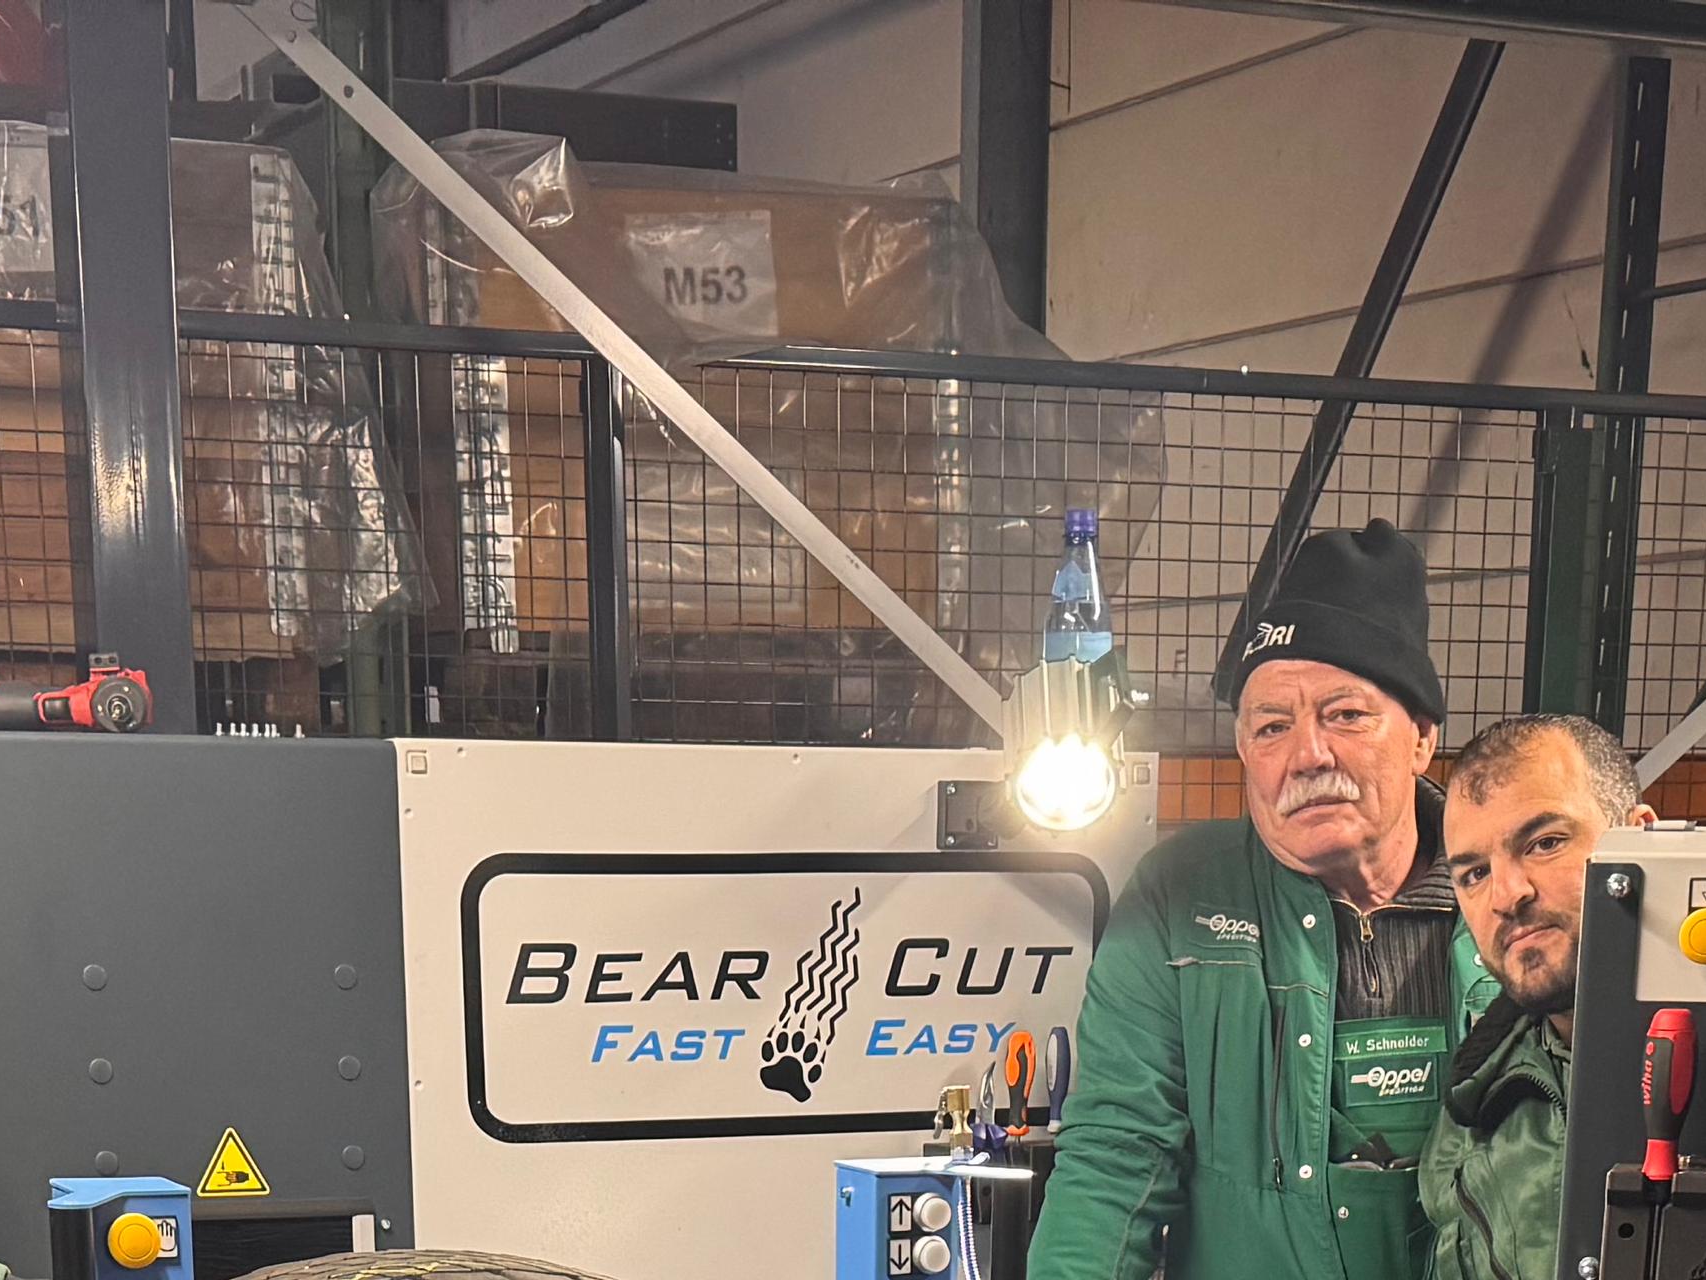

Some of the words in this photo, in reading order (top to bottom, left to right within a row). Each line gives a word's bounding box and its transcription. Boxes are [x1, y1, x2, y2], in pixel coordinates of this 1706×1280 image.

[663, 265, 749, 305] M53
[505, 942, 769, 1005] BEAR
[884, 937, 1073, 997] CUT
[591, 1024, 746, 1063] FAST
[865, 1018, 1017, 1057] EASY
[1367, 1061, 1432, 1090] Oppel
